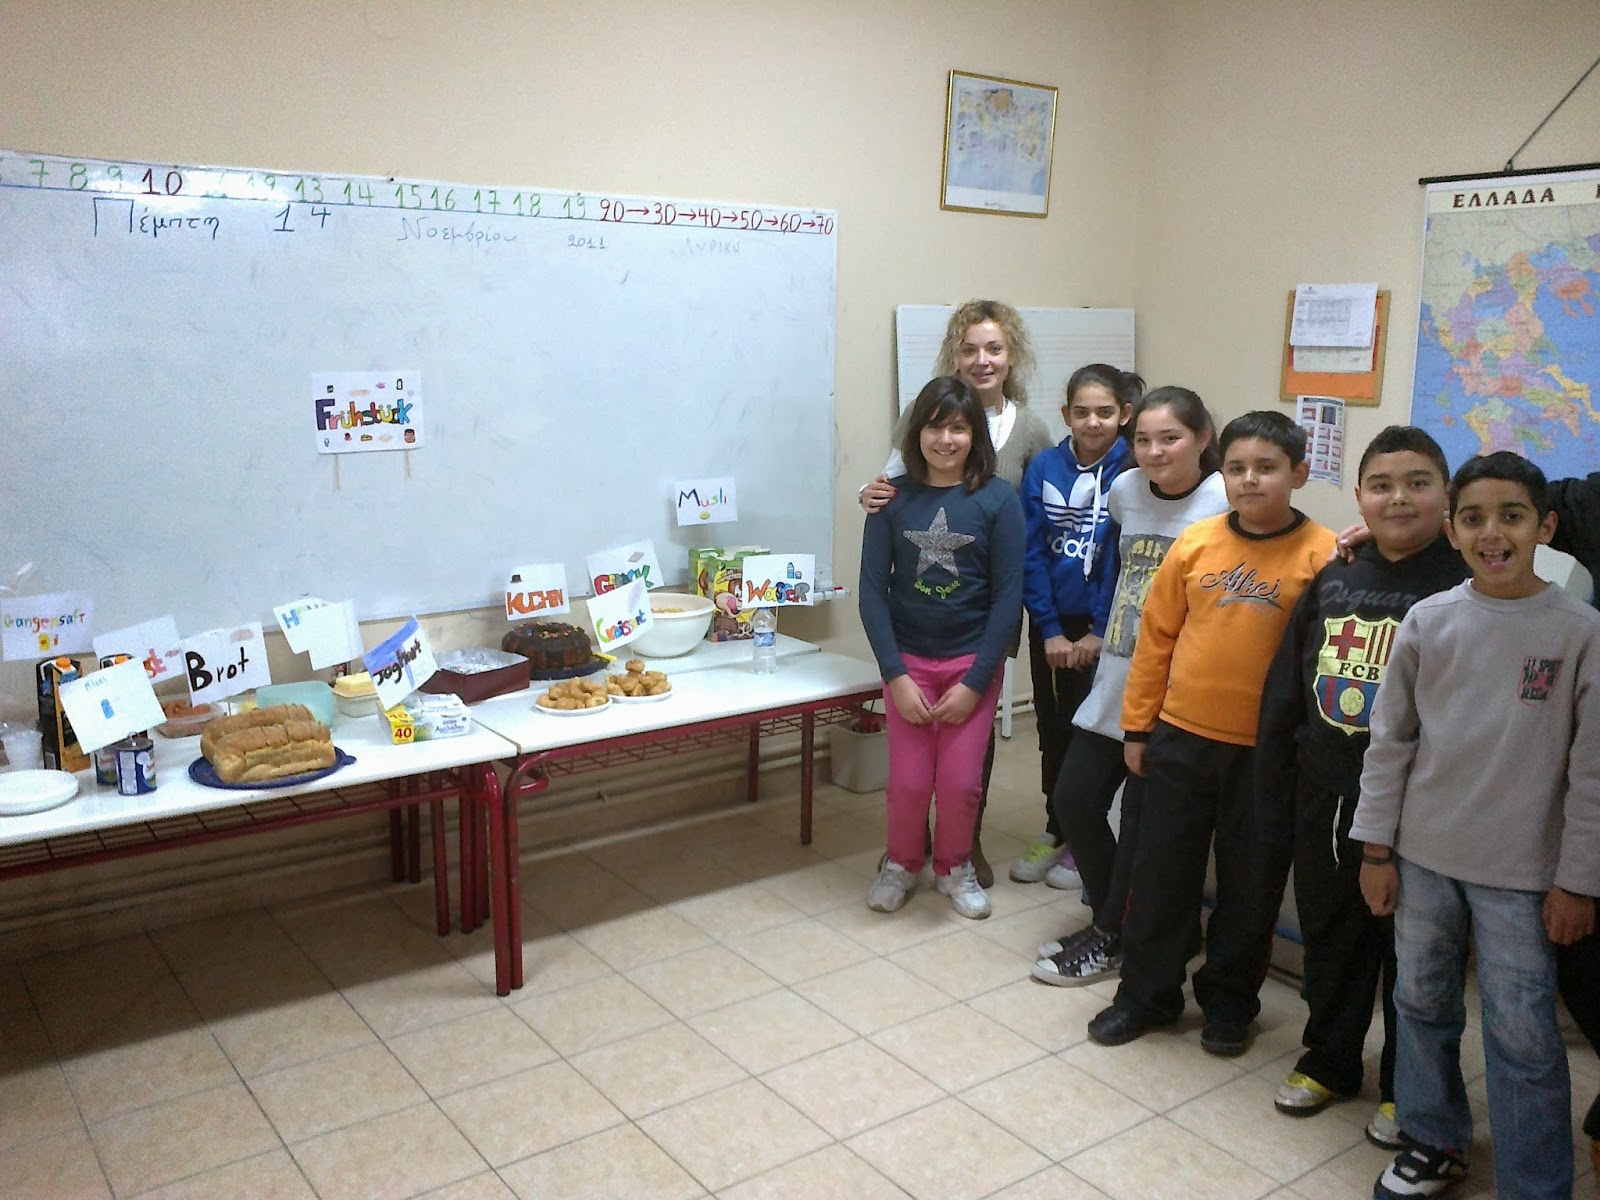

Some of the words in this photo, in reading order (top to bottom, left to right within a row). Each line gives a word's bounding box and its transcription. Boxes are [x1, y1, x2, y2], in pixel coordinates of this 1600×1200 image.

[29, 159, 49, 188] 7
[69, 162, 89, 191] 8
[106, 164, 123, 192] 9
[141, 167, 183, 196] 10
[295, 177, 325, 203] 13
[343, 181, 374, 206] 14
[394, 184, 422, 209] 15
[430, 187, 457, 211] 16
[473, 189, 500, 213] 17
[513, 191, 541, 217] 18
[562, 194, 587, 219] 19
[653, 202, 677, 225] 30
[698, 206, 721, 228] 40
[740, 209, 763, 231] 50
[779, 213, 802, 235] 60
[815, 214, 834, 236] 70
[1453, 187, 1555, 208] ΕΛΛΑΔΑ
[184, 646, 250, 692] Brot
[1339, 661, 1380, 682] FCB
[394, 727, 412, 739] 40
